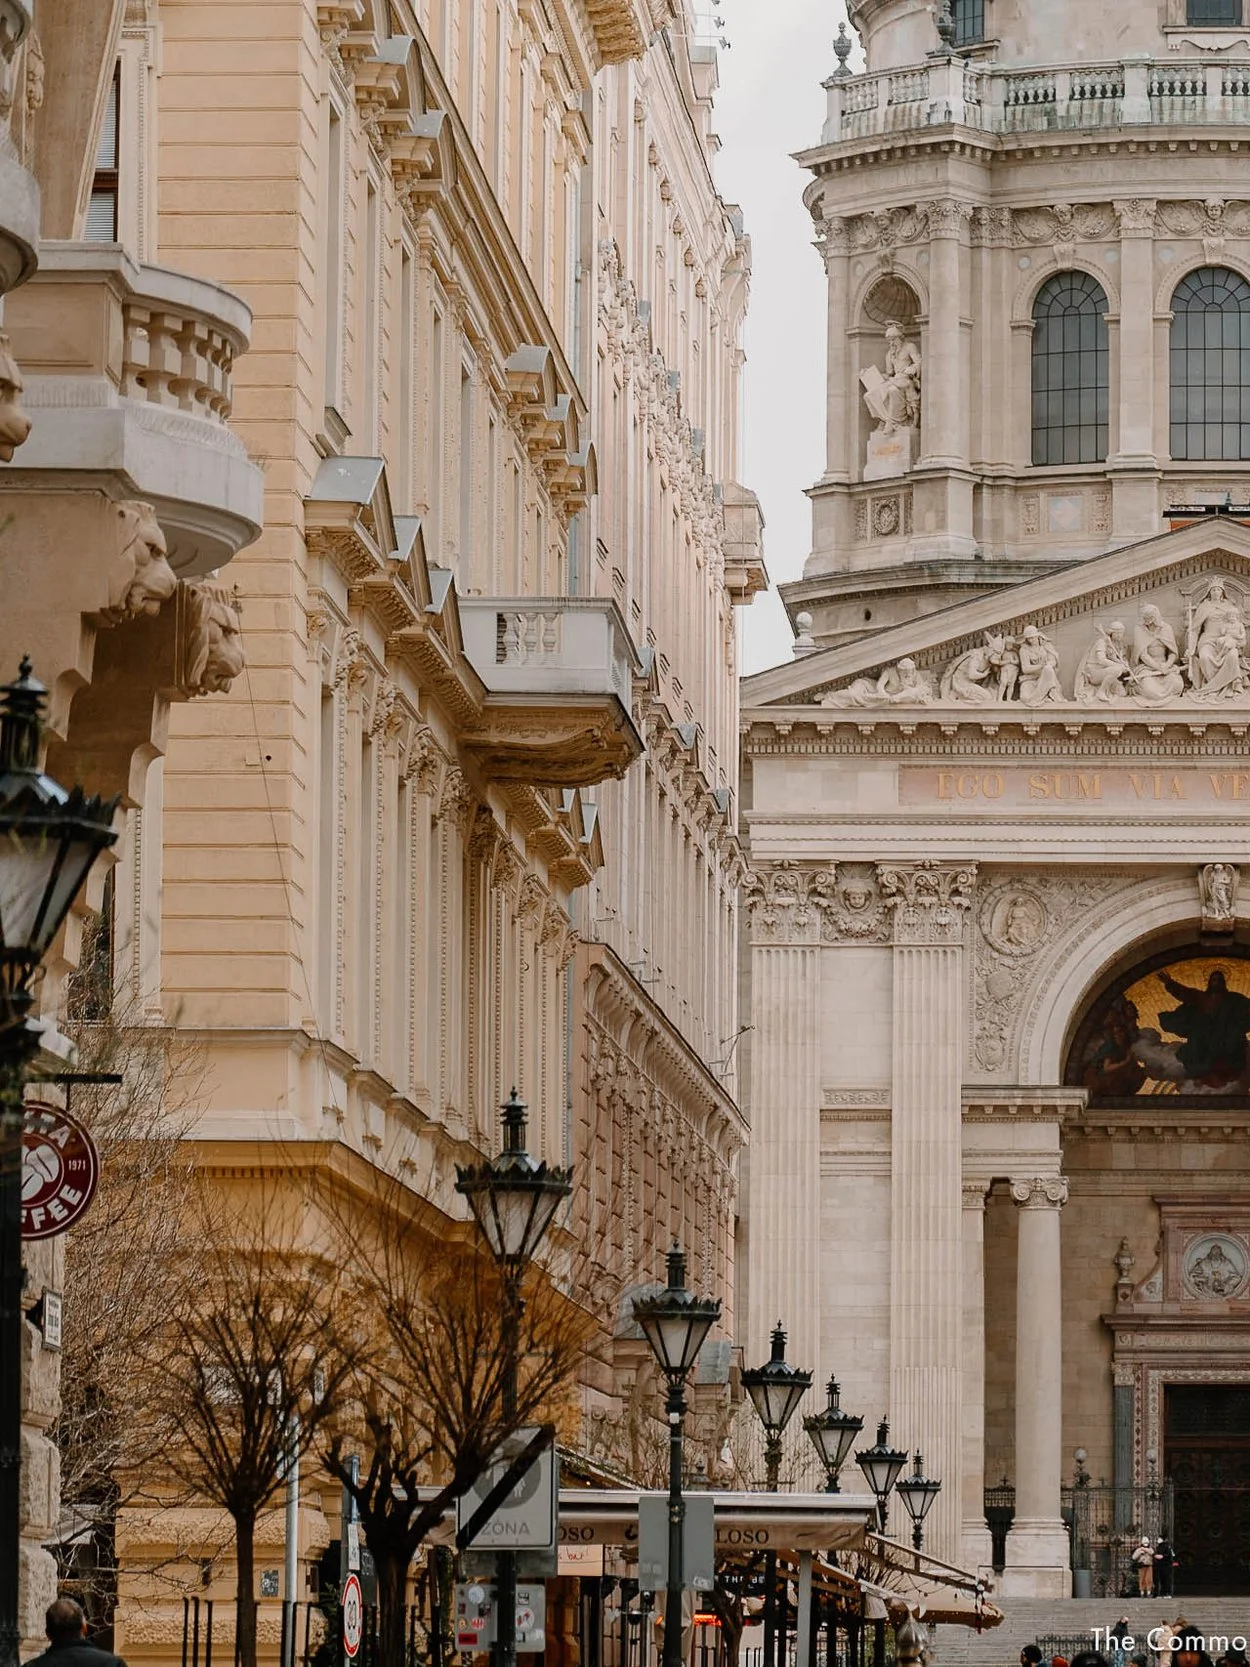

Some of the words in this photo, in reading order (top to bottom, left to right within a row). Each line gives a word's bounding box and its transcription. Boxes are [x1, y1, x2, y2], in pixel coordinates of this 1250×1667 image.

[936, 773, 1005, 800] EGO
[1028, 773, 1103, 801] SUM
[1129, 773, 1189, 800] VIA
[68, 1160, 87, 1172] 1971
[716, 1528, 770, 1545] LOSO
